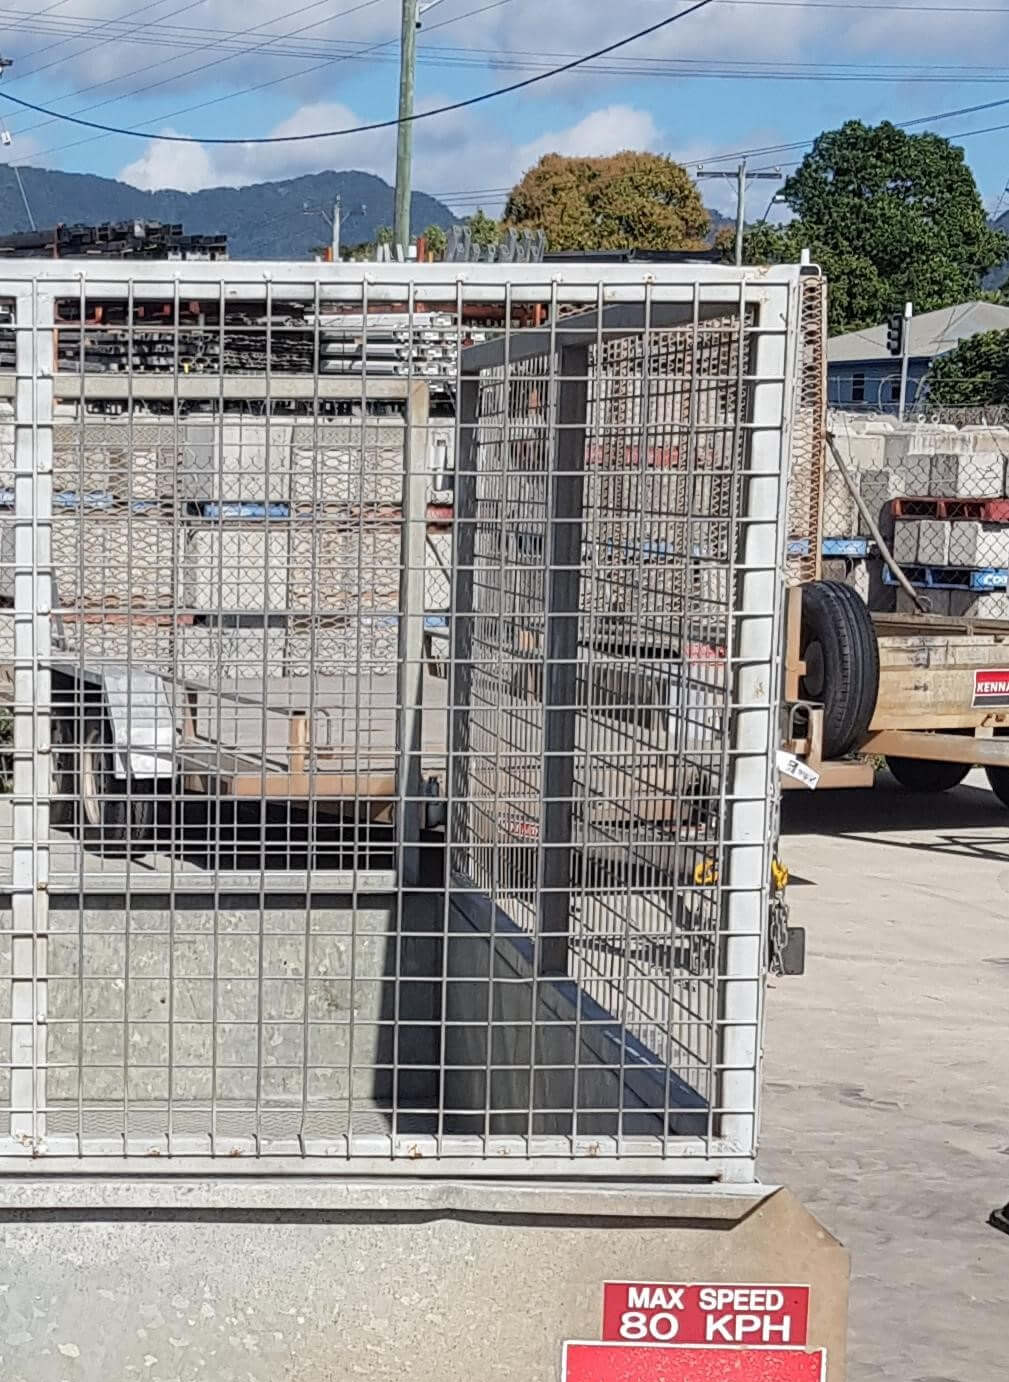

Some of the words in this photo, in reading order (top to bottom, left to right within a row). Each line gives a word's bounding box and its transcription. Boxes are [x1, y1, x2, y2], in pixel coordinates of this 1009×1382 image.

[627, 1286, 685, 1310] MAX
[698, 1289, 784, 1311] SPEED
[619, 1311, 679, 1340] 80
[705, 1314, 791, 1342] KPH
